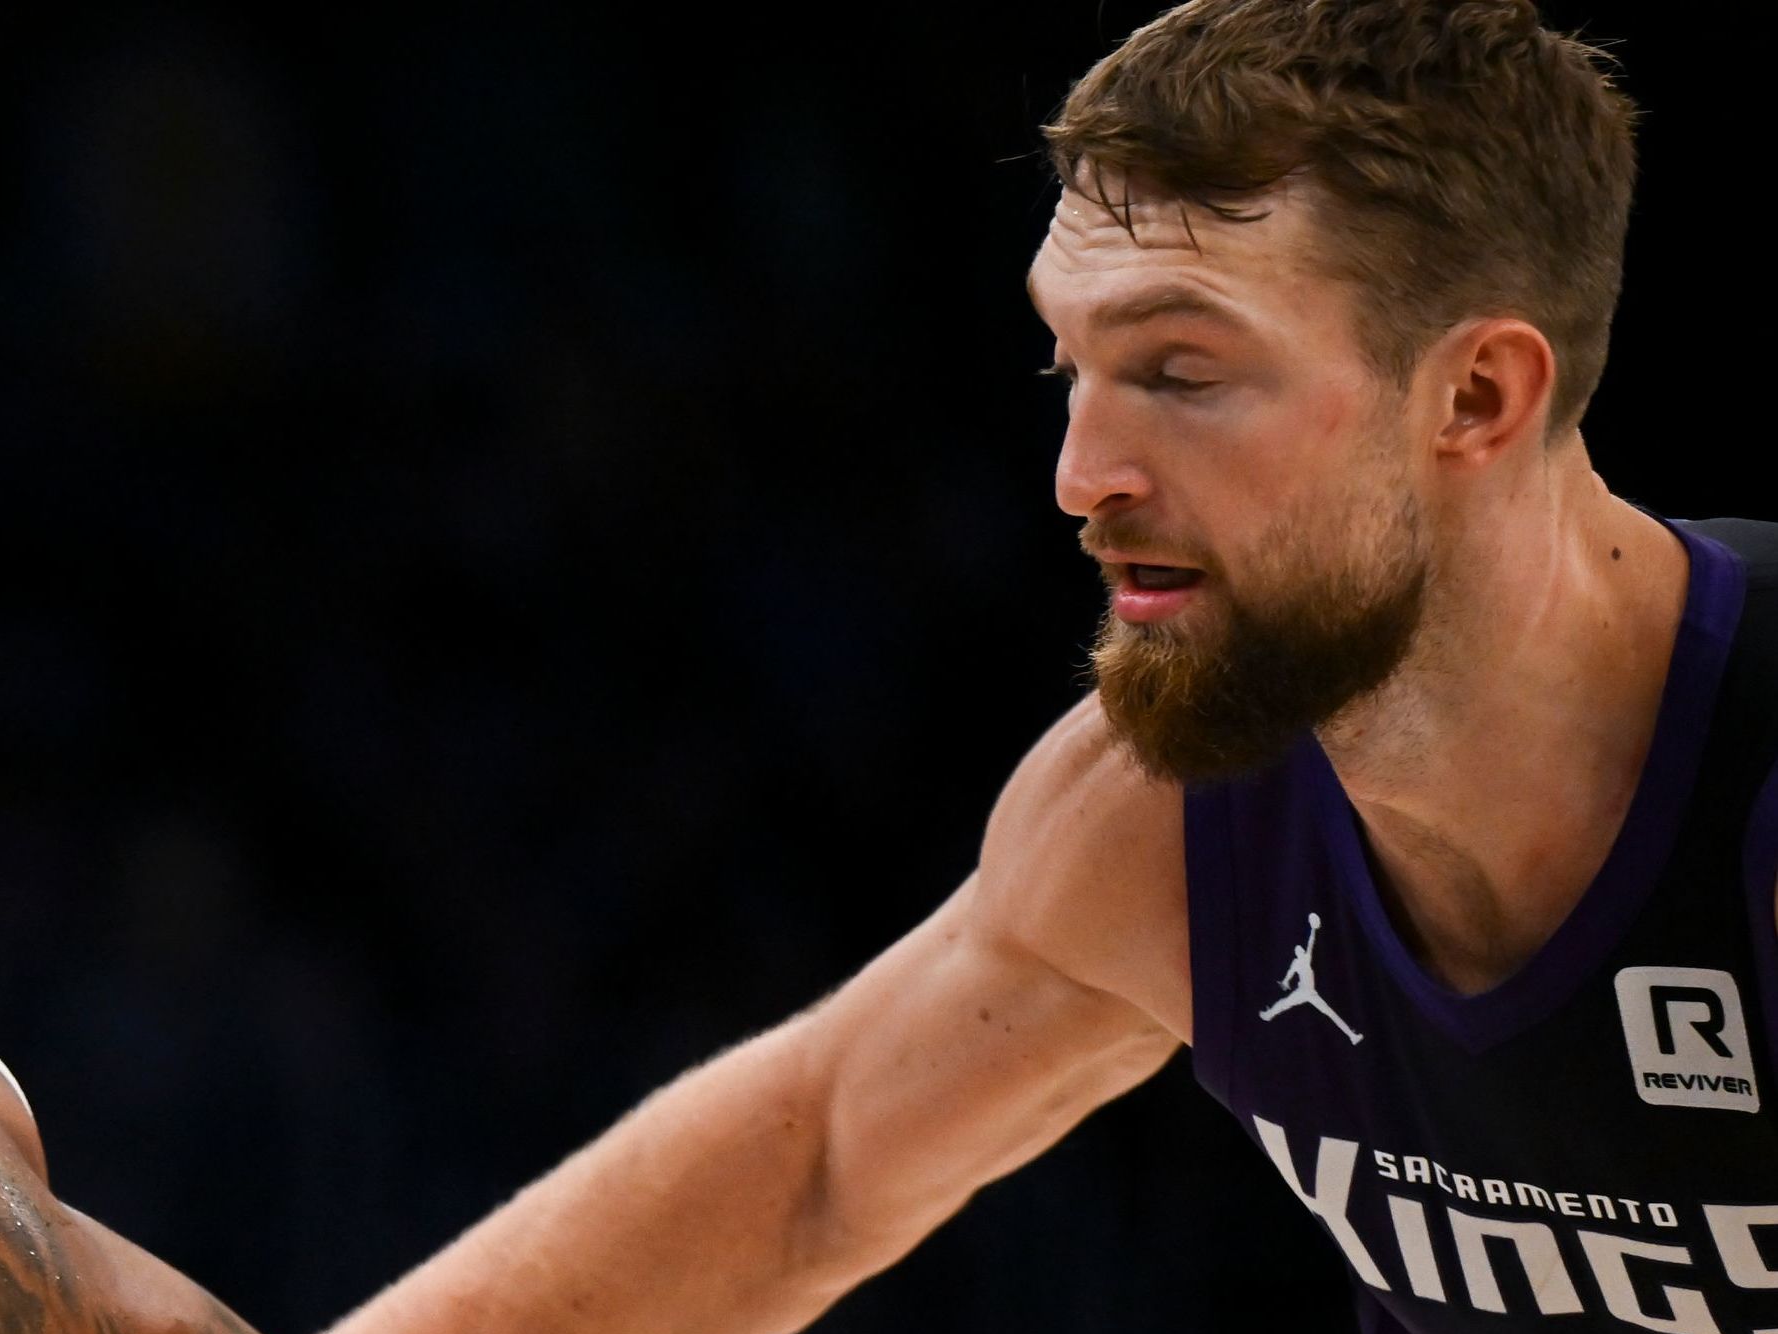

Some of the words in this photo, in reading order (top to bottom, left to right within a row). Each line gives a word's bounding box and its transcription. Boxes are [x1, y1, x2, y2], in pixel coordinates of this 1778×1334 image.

[1649, 985, 1734, 1059] R
[1642, 1071, 1753, 1097] REVIVER
[1373, 1149, 1679, 1228] SACRAMENTO
